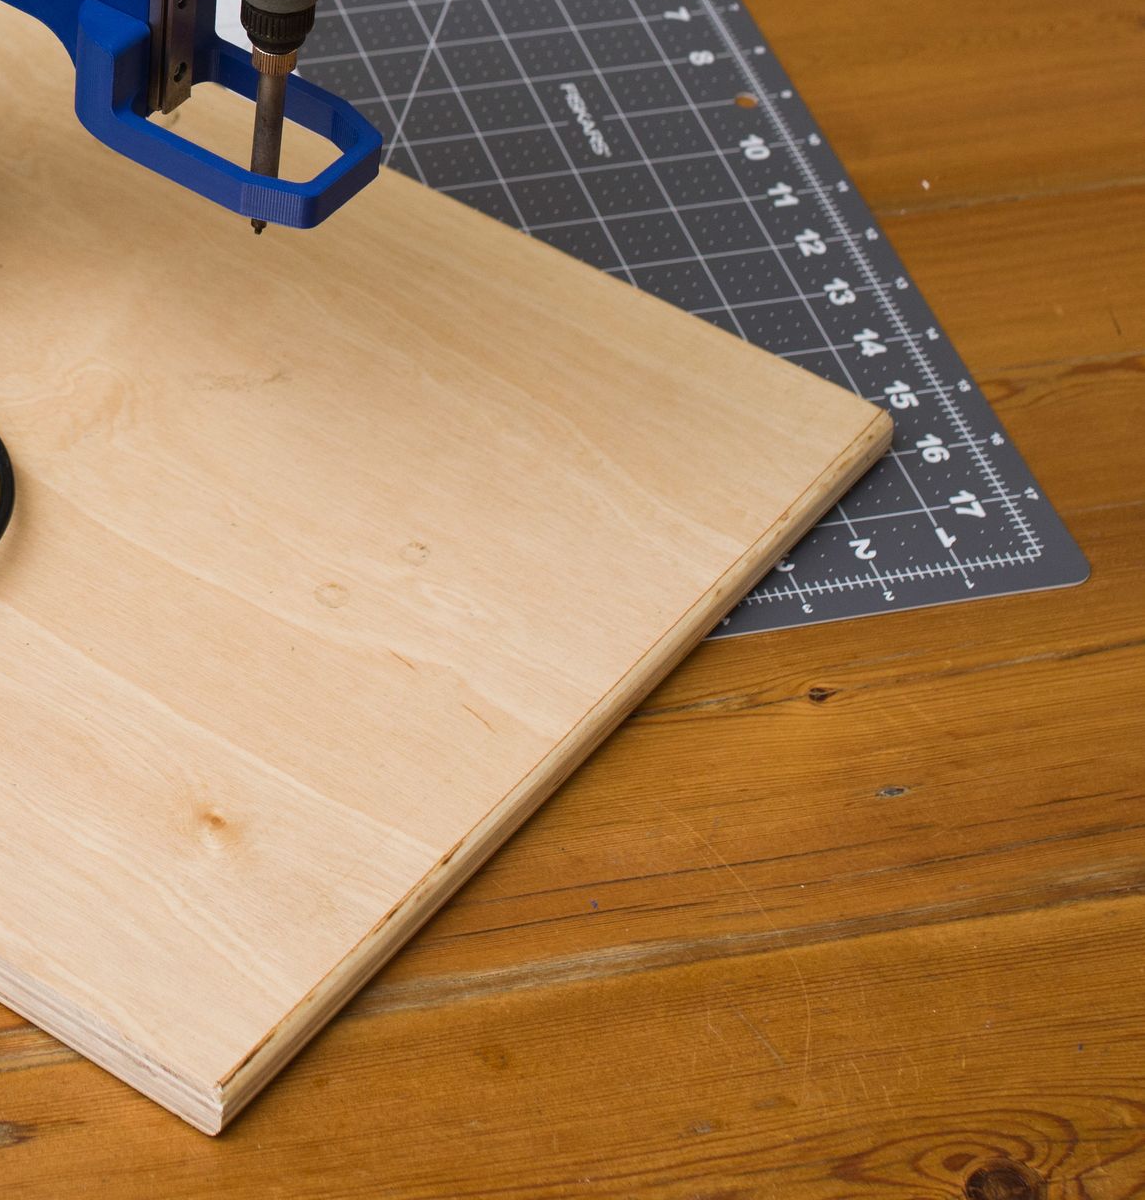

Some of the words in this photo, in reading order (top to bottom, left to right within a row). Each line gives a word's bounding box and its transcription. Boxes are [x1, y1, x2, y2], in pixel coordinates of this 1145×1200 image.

[689, 50, 715, 66] 8
[739, 134, 771, 160] 10
[767, 181, 800, 208] 11
[794, 228, 827, 257] 12
[823, 277, 856, 306] 13
[852, 328, 887, 358] 14
[884, 380, 919, 410] 15
[915, 433, 950, 464] 16
[948, 490, 987, 518] 17
[1023, 486, 1040, 501] 17
[848, 538, 877, 560] 2
[935, 527, 957, 548] 1
[883, 591, 895, 601] 2
[964, 579, 975, 589] 1
[802, 604, 814, 614] 3
